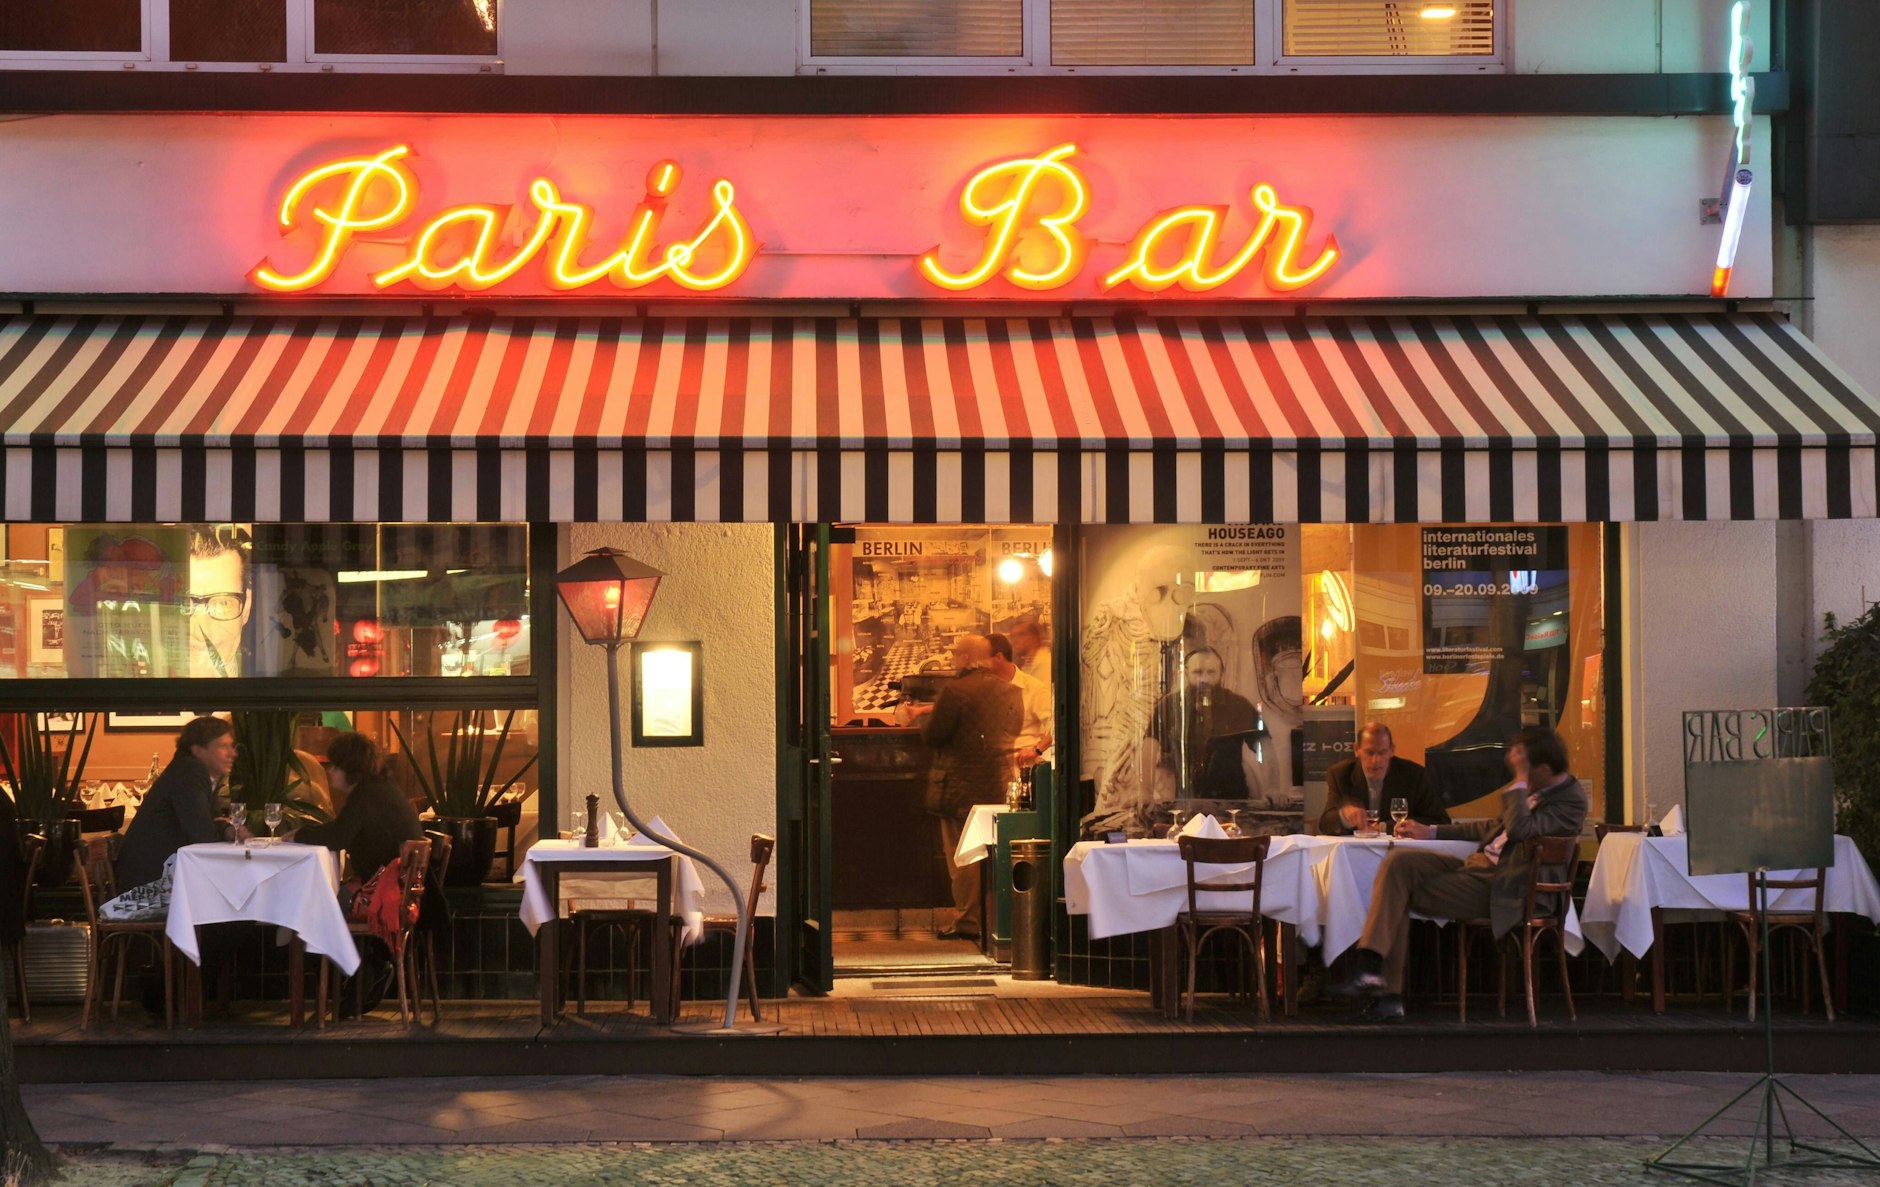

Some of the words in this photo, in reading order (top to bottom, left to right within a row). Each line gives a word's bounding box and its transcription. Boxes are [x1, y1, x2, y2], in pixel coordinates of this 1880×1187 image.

[249, 142, 764, 293] Paris
[915, 142, 1341, 293] Bar
[1208, 527, 1285, 539] HOUSEAGO
[1423, 530, 1535, 543] internationales
[862, 541, 923, 556] BERLIN
[1423, 543, 1537, 556] literaturfestival
[1423, 557, 1466, 569] berlin
